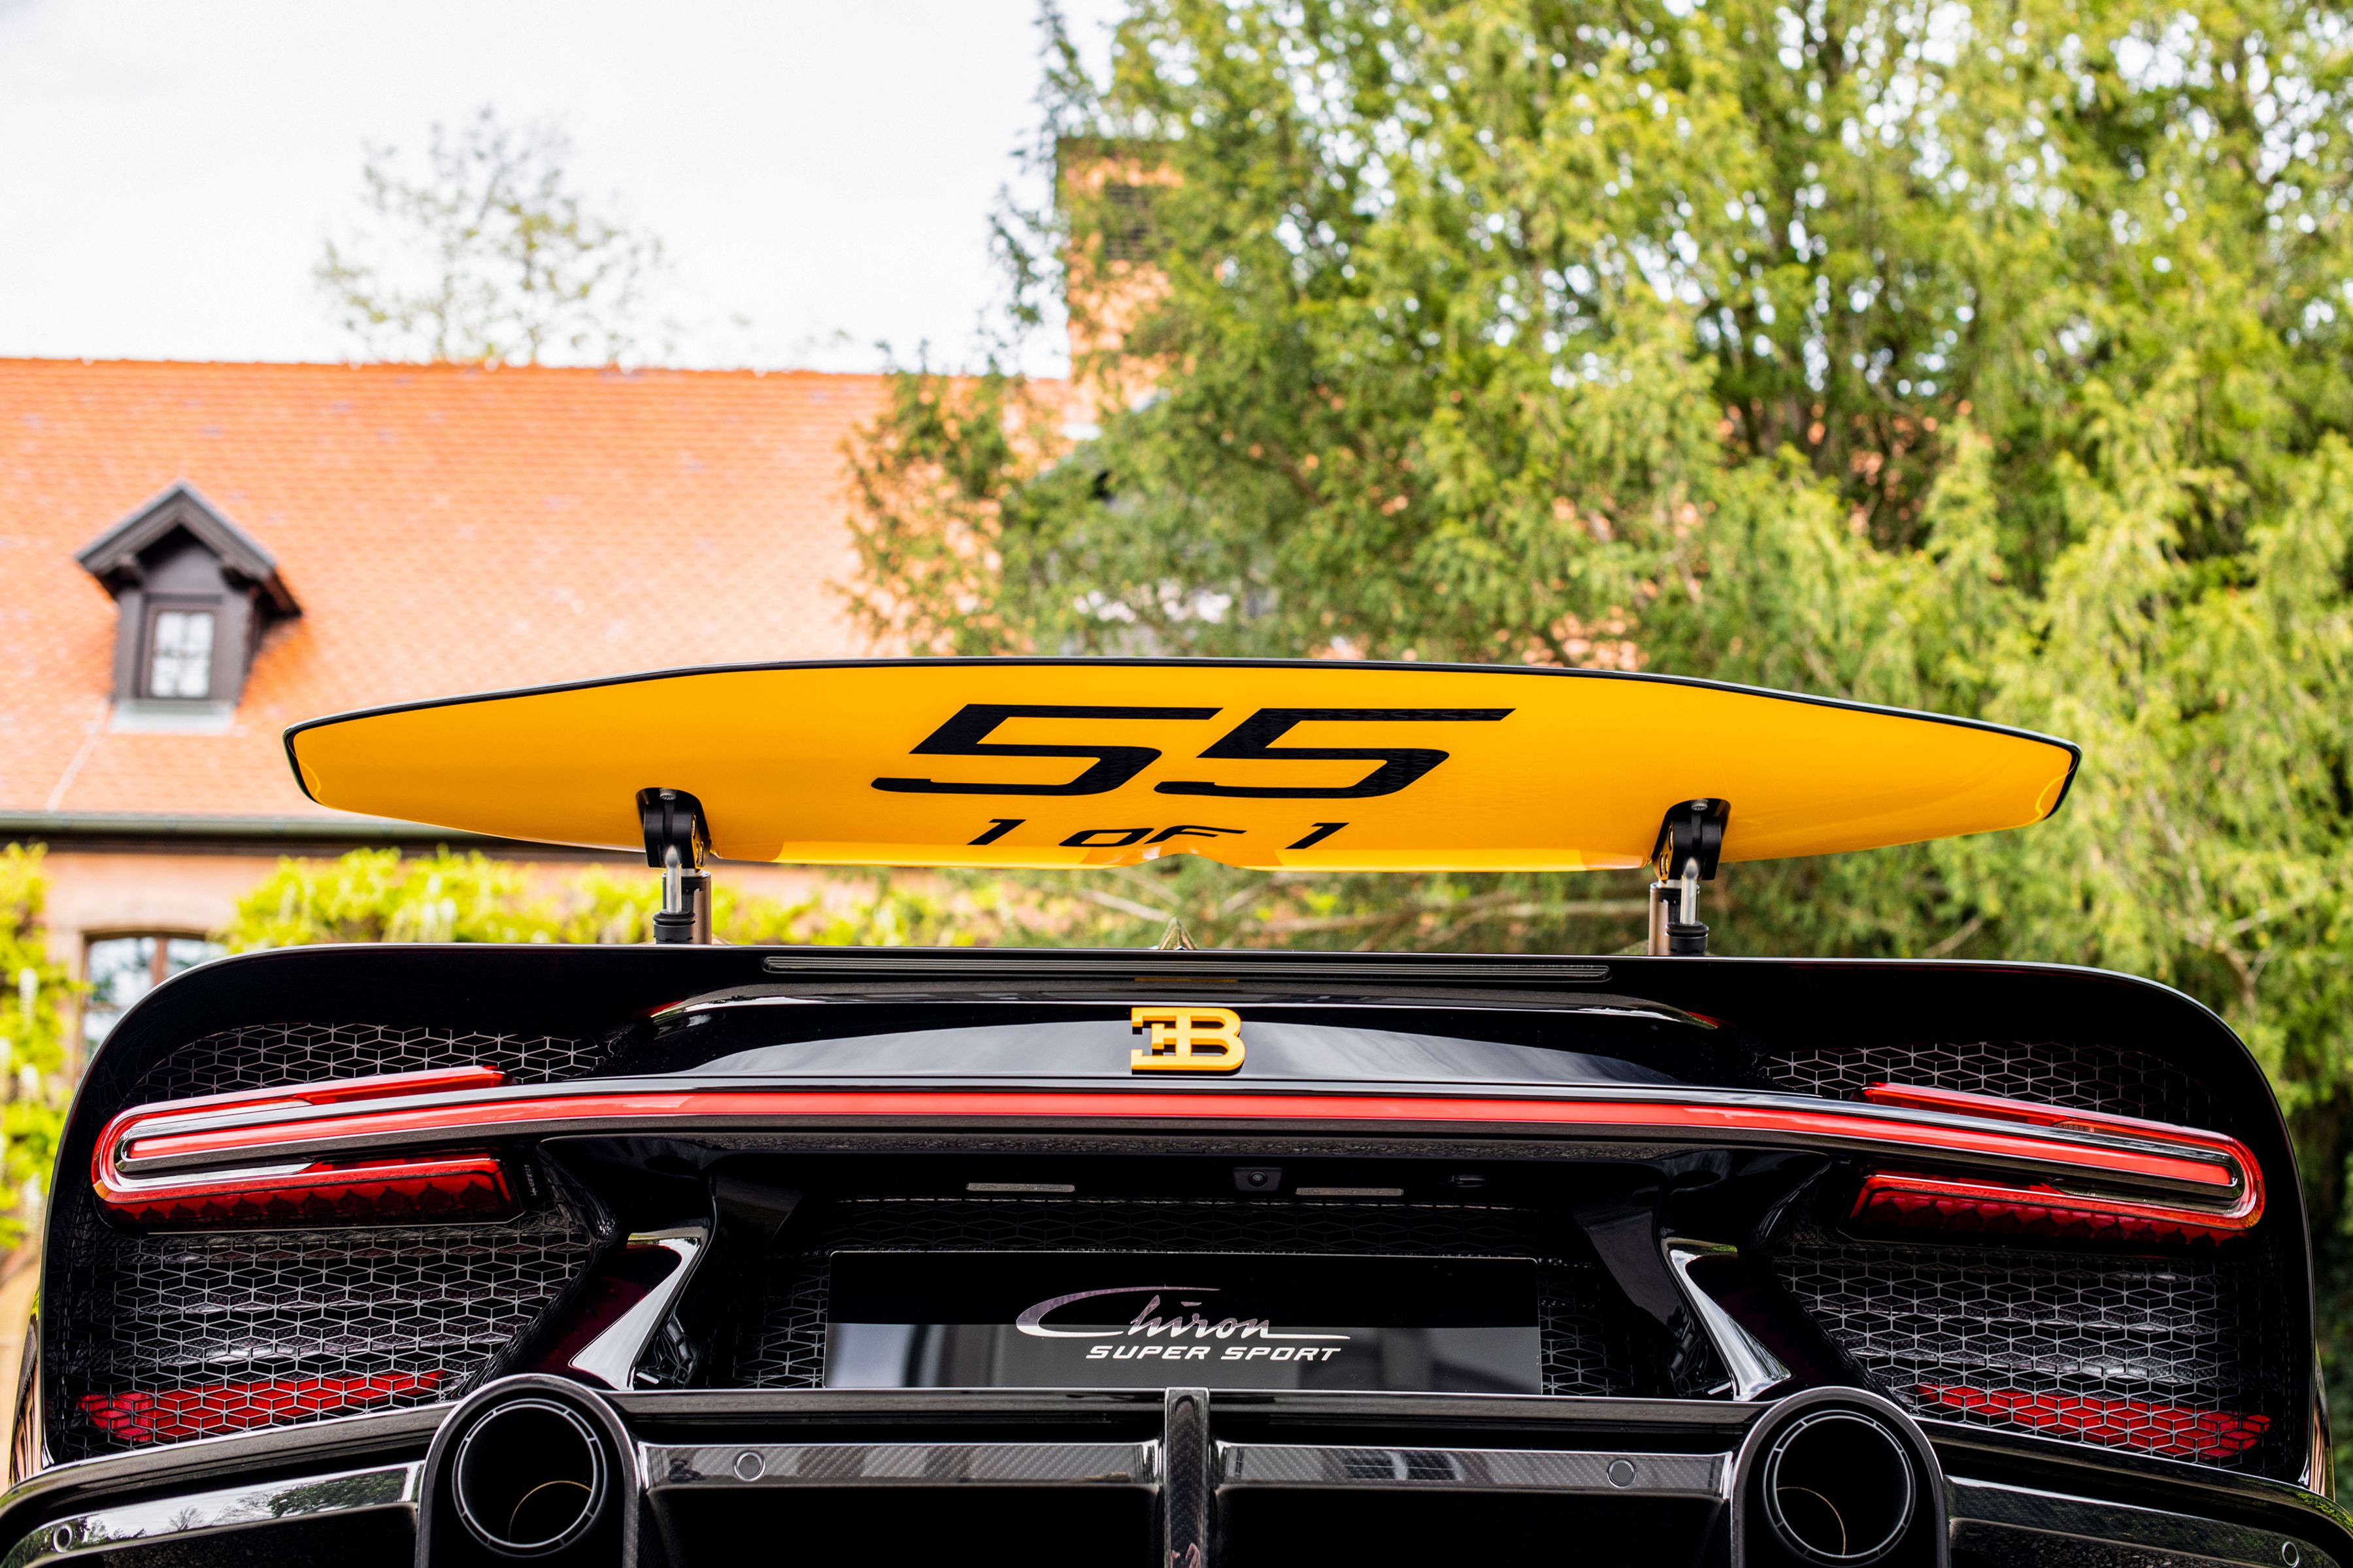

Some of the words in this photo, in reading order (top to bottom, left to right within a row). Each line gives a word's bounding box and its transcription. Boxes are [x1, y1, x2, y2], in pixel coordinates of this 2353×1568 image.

[871, 703, 1516, 799] 55
[967, 818, 1027, 846] 1
[1058, 825, 1247, 848] OF
[1285, 822, 1350, 850] 1
[1016, 1285, 1351, 1340] Chiron
[1085, 1345, 1211, 1360] SUPER
[1220, 1346, 1342, 1361] SPORT
